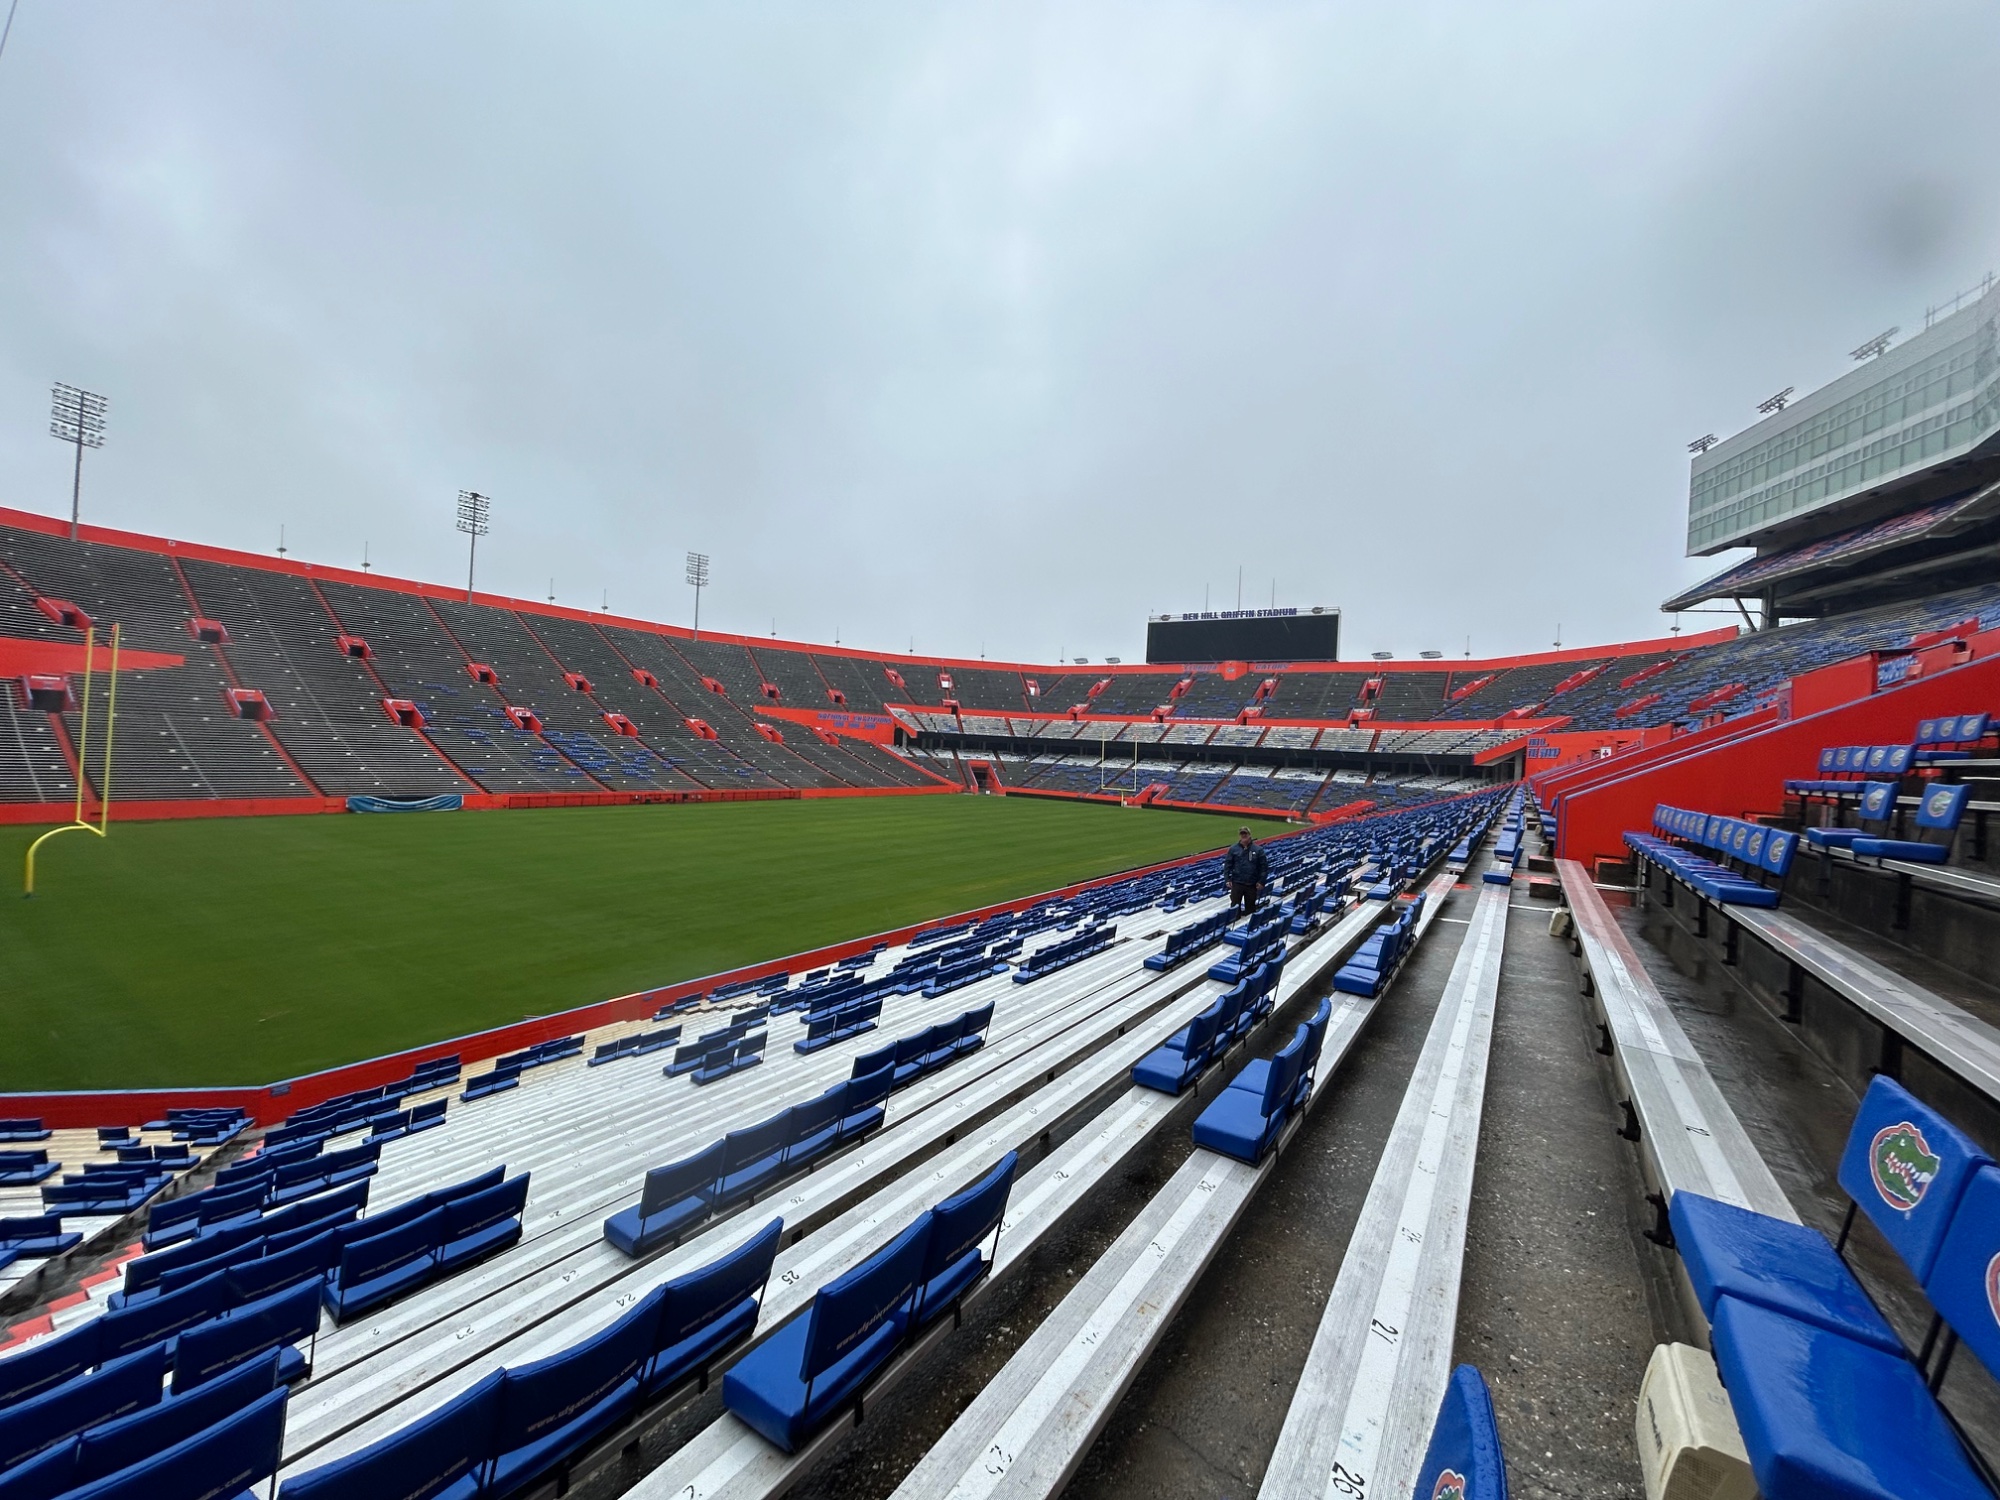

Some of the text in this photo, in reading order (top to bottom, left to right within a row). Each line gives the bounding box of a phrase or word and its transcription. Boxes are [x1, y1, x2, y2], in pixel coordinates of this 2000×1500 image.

[1182, 608, 1297, 621] BEN HILL GRIFFIN STADIUM
[781, 1269, 800, 1285] 25
[615, 1292, 637, 1307] 24
[1331, 1461, 1366, 1500] 26
